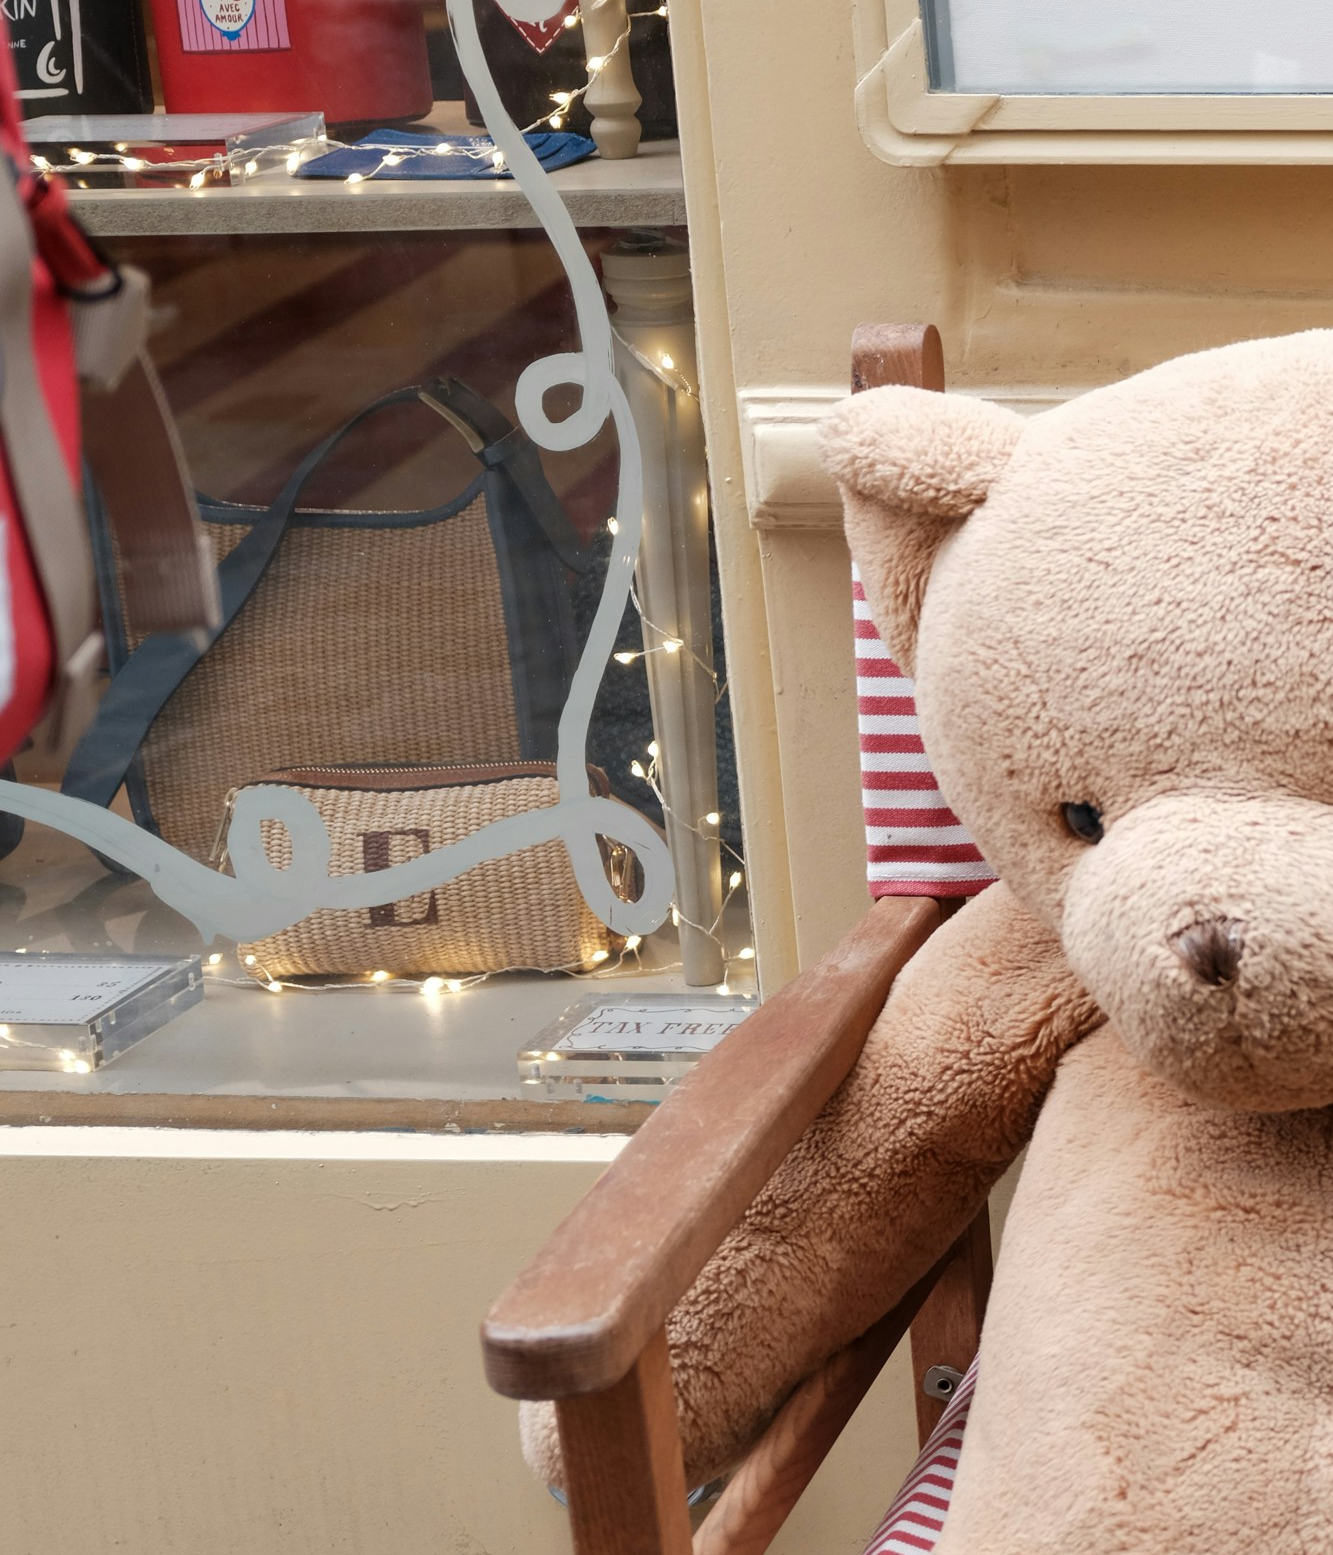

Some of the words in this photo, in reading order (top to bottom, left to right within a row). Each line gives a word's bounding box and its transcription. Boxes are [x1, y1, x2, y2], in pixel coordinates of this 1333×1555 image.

[219, 4, 241, 13] AVEC
[215, 14, 244, 23] AMOUR
[357, 828, 440, 929] E
[588, 1021, 649, 1035] TAX
[656, 1022, 741, 1036] FREE
